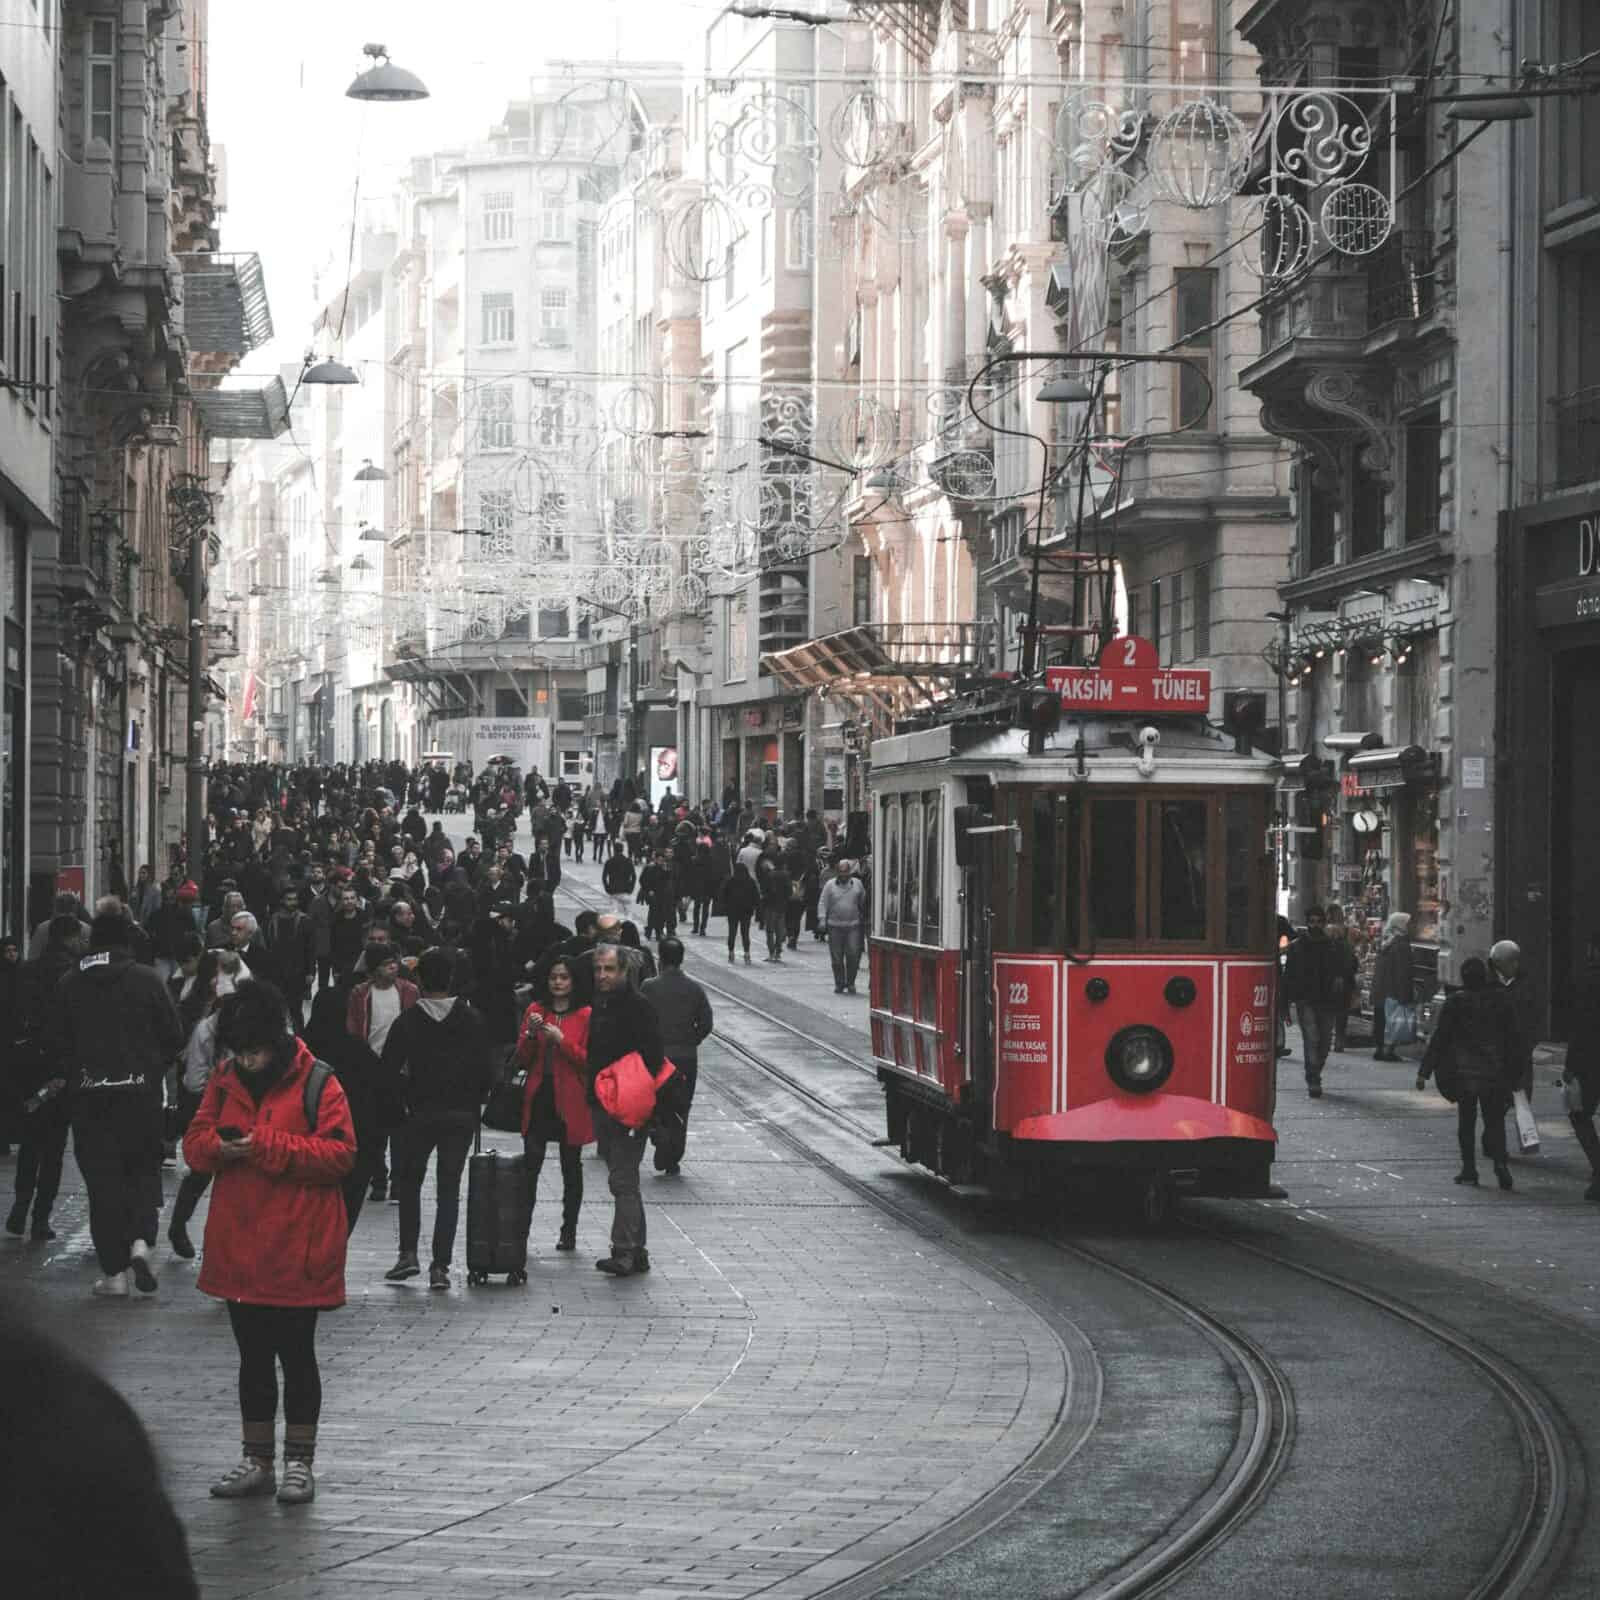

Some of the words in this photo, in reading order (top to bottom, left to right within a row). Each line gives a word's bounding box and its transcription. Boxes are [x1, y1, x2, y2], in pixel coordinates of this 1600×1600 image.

[1124, 639, 1136, 666] 2
[1052, 674, 1113, 700] TAKSİM
[1152, 673, 1205, 701] TÜNEL
[1009, 983, 1028, 1004] 223
